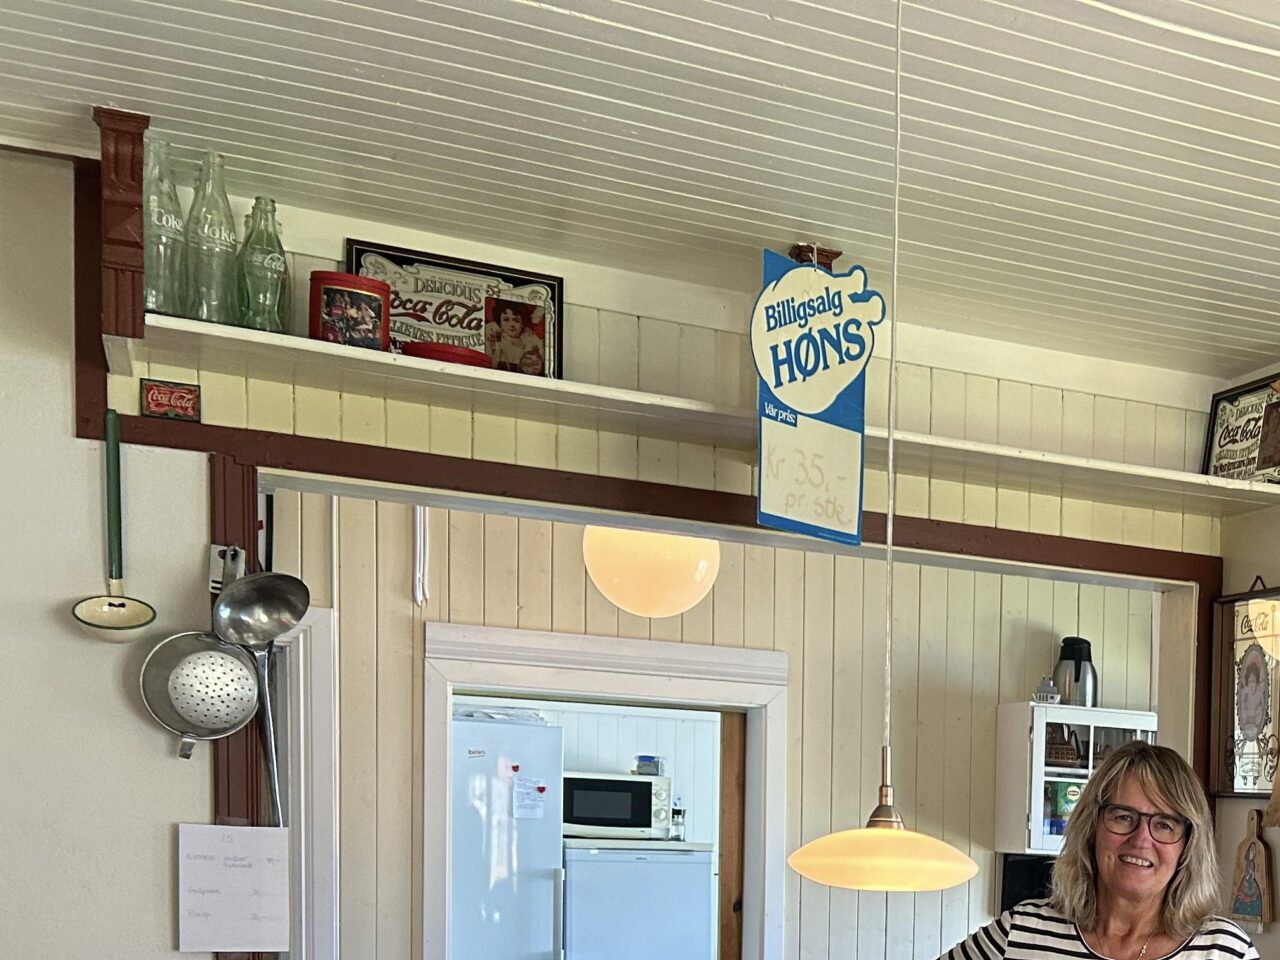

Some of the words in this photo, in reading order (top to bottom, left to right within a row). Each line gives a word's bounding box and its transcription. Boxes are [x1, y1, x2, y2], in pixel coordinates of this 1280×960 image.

[391, 289, 433, 314] oca
[413, 277, 482, 304] DELICIOUS
[764, 288, 844, 333] Billigsalg
[390, 318, 435, 342] LIEVES
[769, 318, 867, 389] HØNS
[777, 409, 796, 423] pris:
